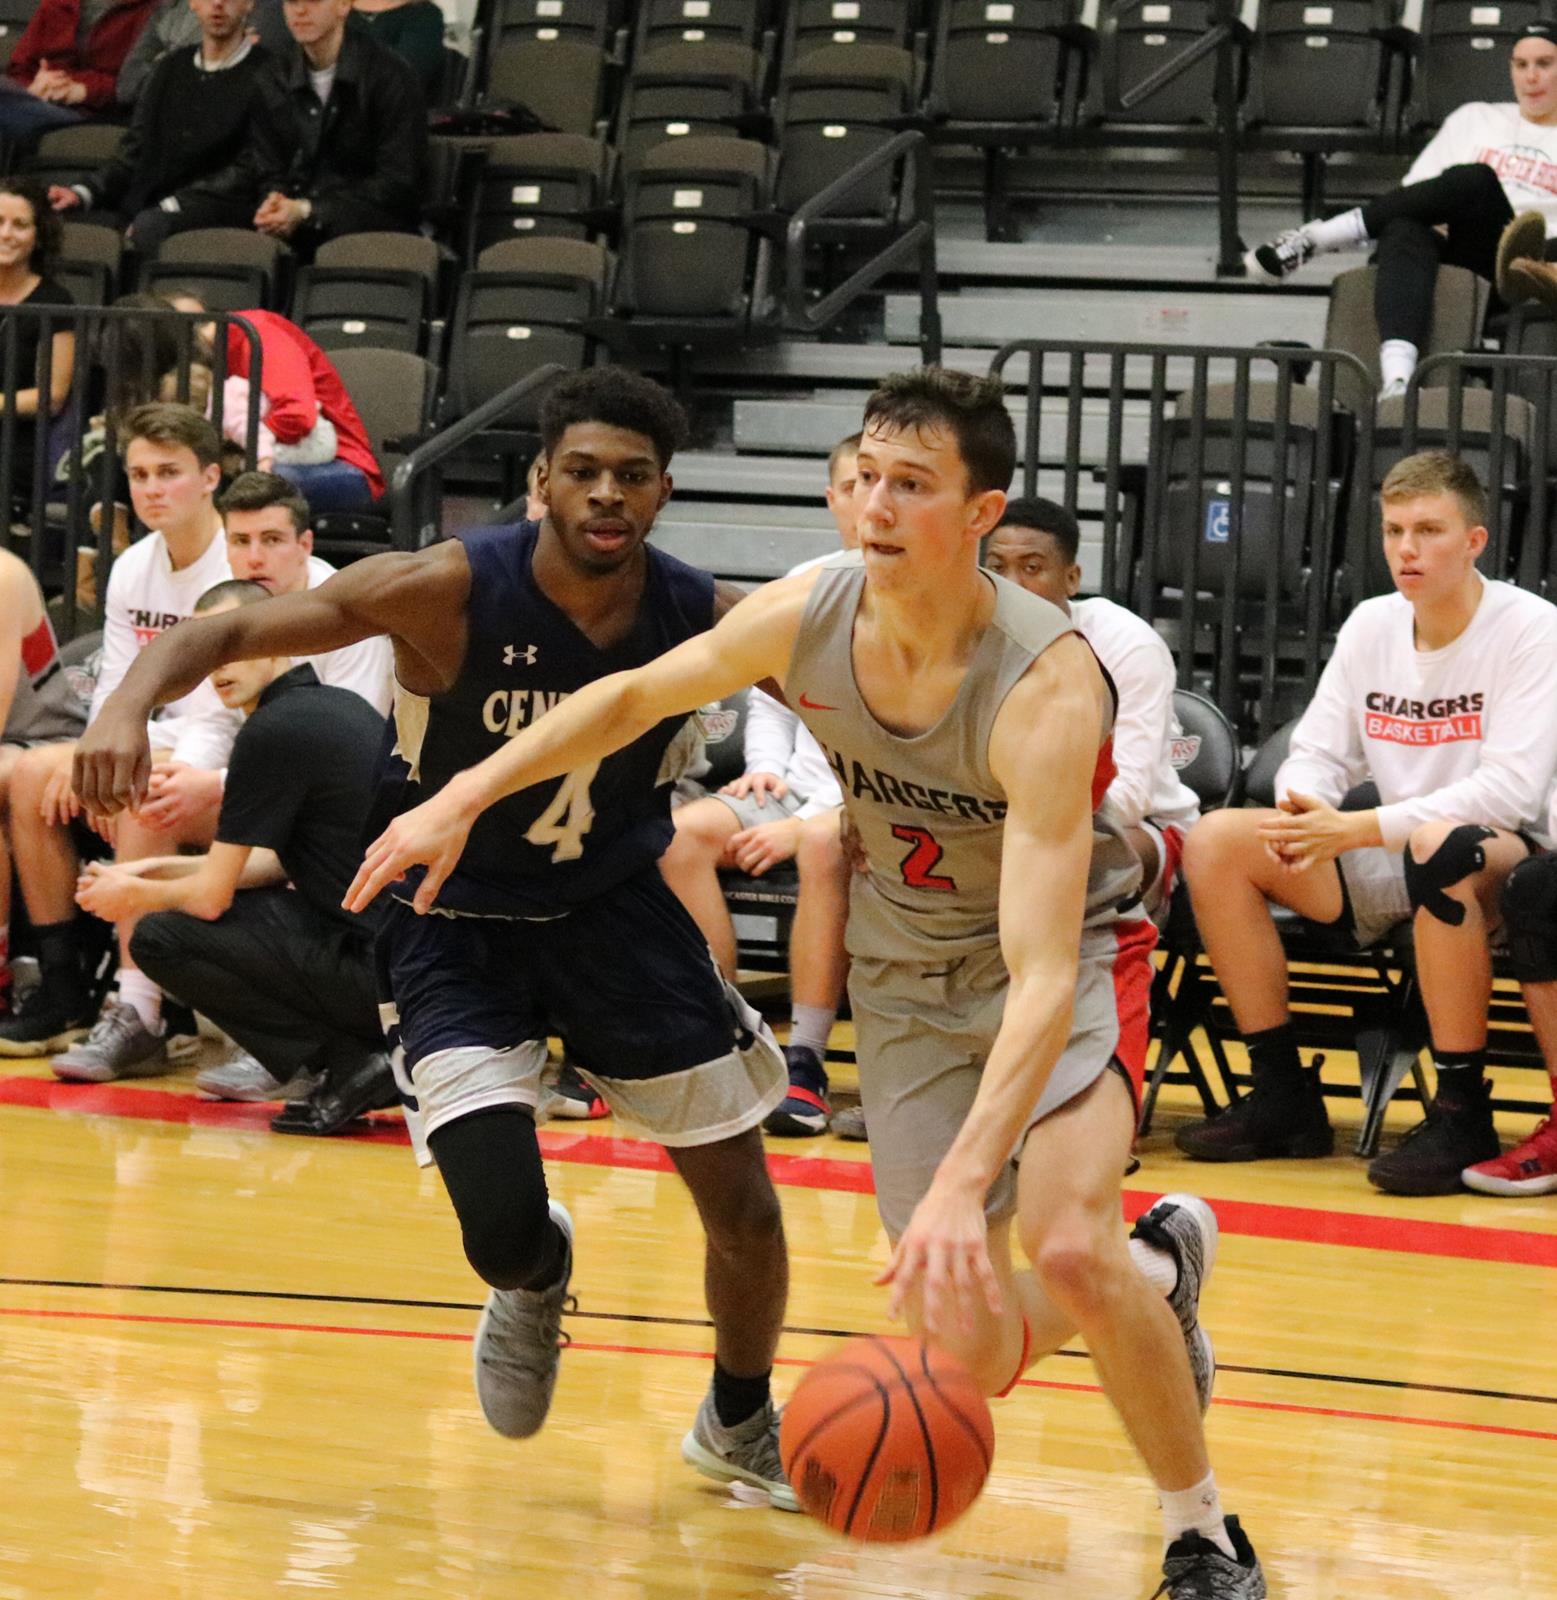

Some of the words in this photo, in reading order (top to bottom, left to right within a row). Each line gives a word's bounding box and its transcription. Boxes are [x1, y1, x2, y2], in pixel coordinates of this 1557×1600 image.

[521, 757, 602, 865] 4
[821, 743, 1009, 824] HARGERS
[889, 822, 958, 890] 2
